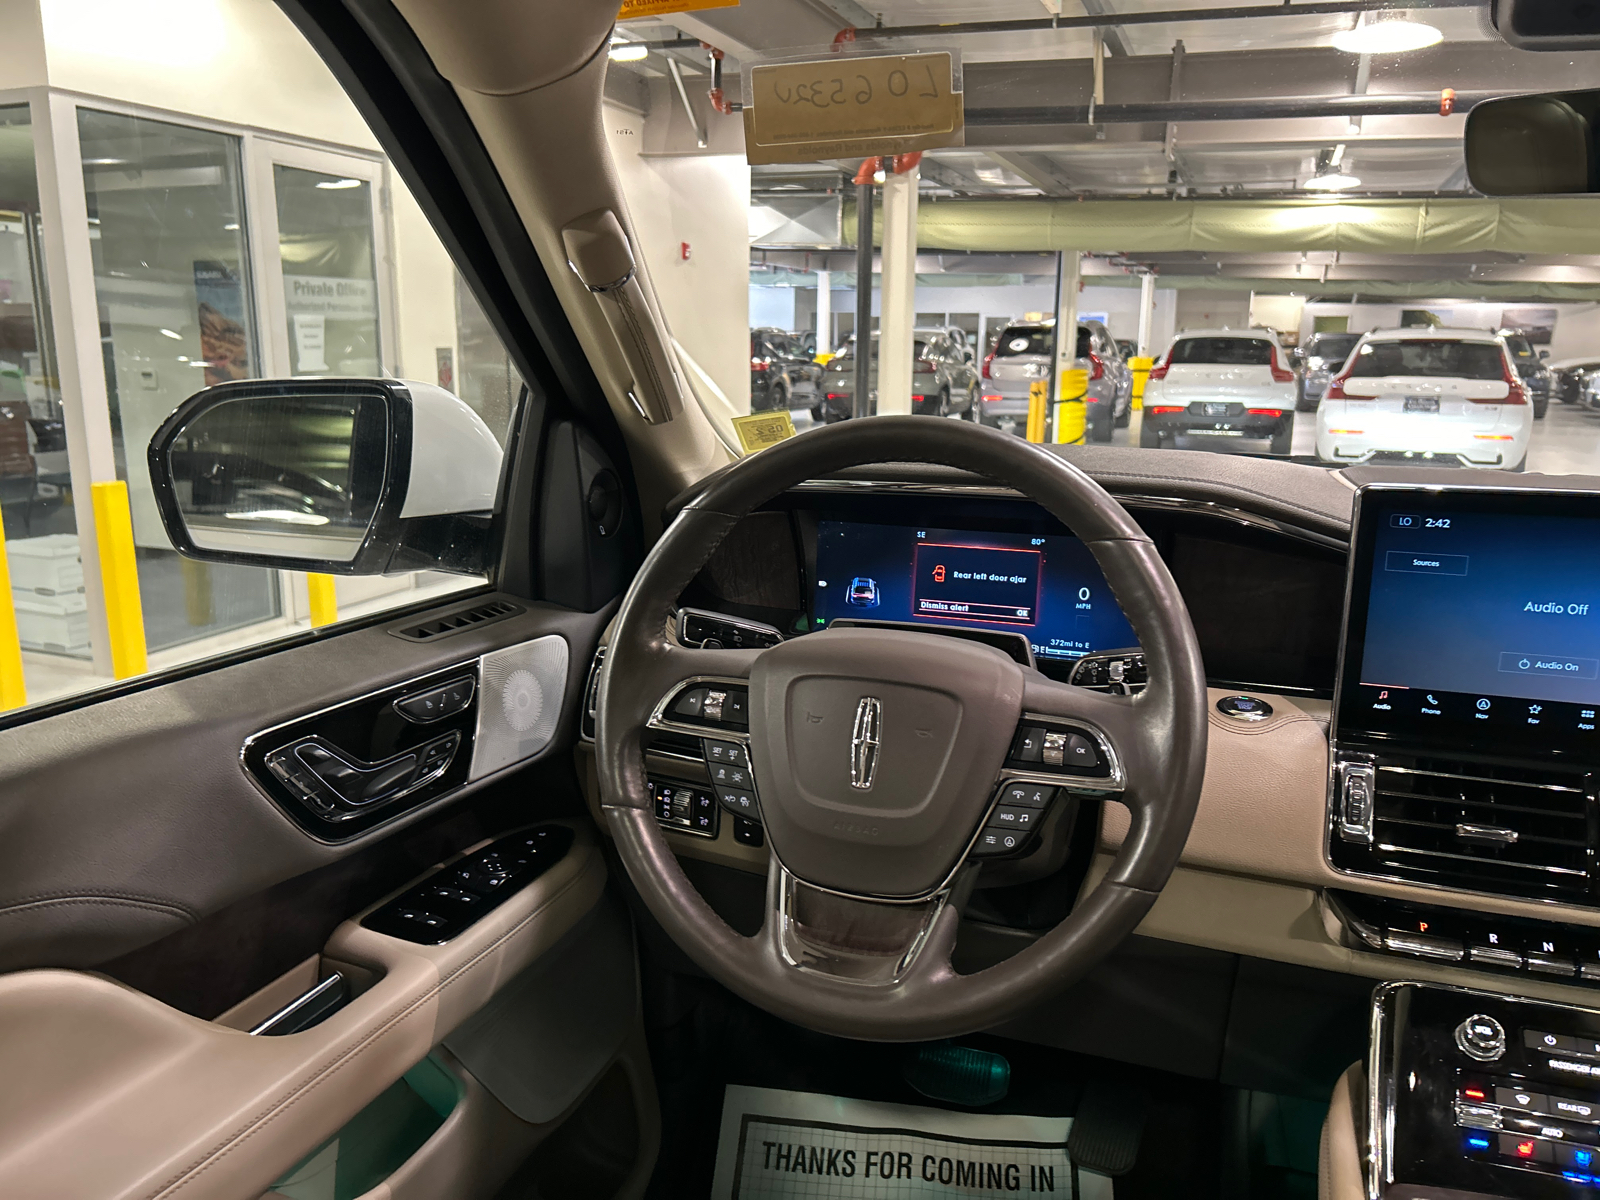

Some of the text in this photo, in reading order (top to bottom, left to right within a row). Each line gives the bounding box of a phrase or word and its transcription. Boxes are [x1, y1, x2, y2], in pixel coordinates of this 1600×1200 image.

[293, 281, 334, 297] Private
[1399, 517, 1412, 526] LO
[1425, 518, 1451, 529] 2:42
[917, 531, 926, 539] SE
[1413, 559, 1440, 567] Sources
[954, 571, 1027, 585] Rear left door ajar
[1078, 587, 1090, 601] 0
[920, 600, 969, 612] Dismiss alert
[1523, 601, 1589, 616] Audio Off
[1017, 609, 1028, 617] OK
[1050, 638, 1073, 648] 372mi
[1075, 640, 1083, 648] to
[1535, 661, 1579, 672] Audio On
[1421, 707, 1441, 715] Phone
[1527, 717, 1540, 725] Fav
[1577, 722, 1595, 731] Apps
[1000, 813, 1015, 821] HUD
[1419, 921, 1428, 932] P
[1489, 932, 1498, 944] R
[1543, 942, 1554, 953] N
[763, 1141, 1055, 1192] THANKS FOR COMING IN
